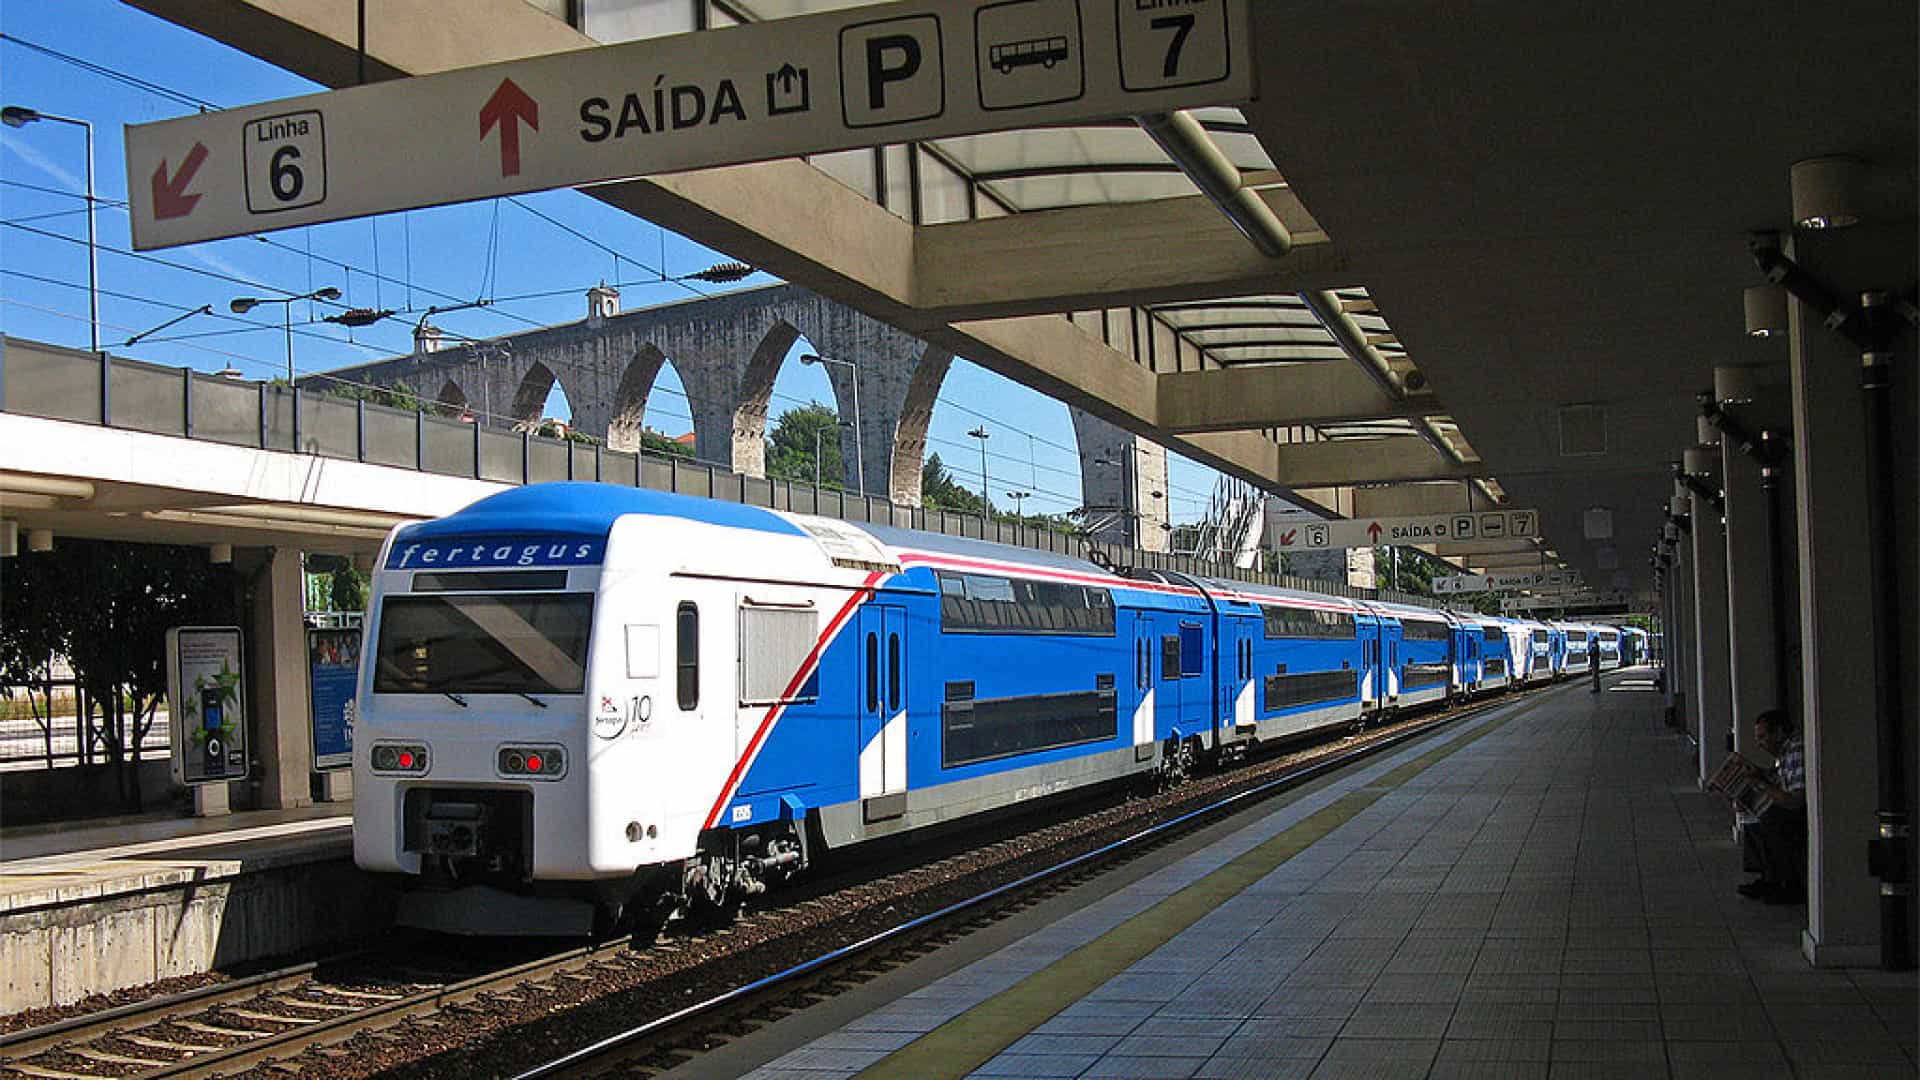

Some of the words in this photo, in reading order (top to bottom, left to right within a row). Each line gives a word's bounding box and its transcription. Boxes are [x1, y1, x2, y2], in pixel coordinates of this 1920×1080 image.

[1151, 14, 1195, 77] 7
[866, 34, 922, 109] P
[579, 73, 746, 142] SAÍDA
[257, 117, 309, 142] Linha
[269, 145, 304, 201] 6
[1313, 532, 1323, 545] 6
[1392, 522, 1431, 538] SAÍDA
[1457, 520, 1470, 536] P
[1517, 520, 1527, 533] 7
[399, 543, 592, 568] fertagus
[631, 695, 652, 722] 10
